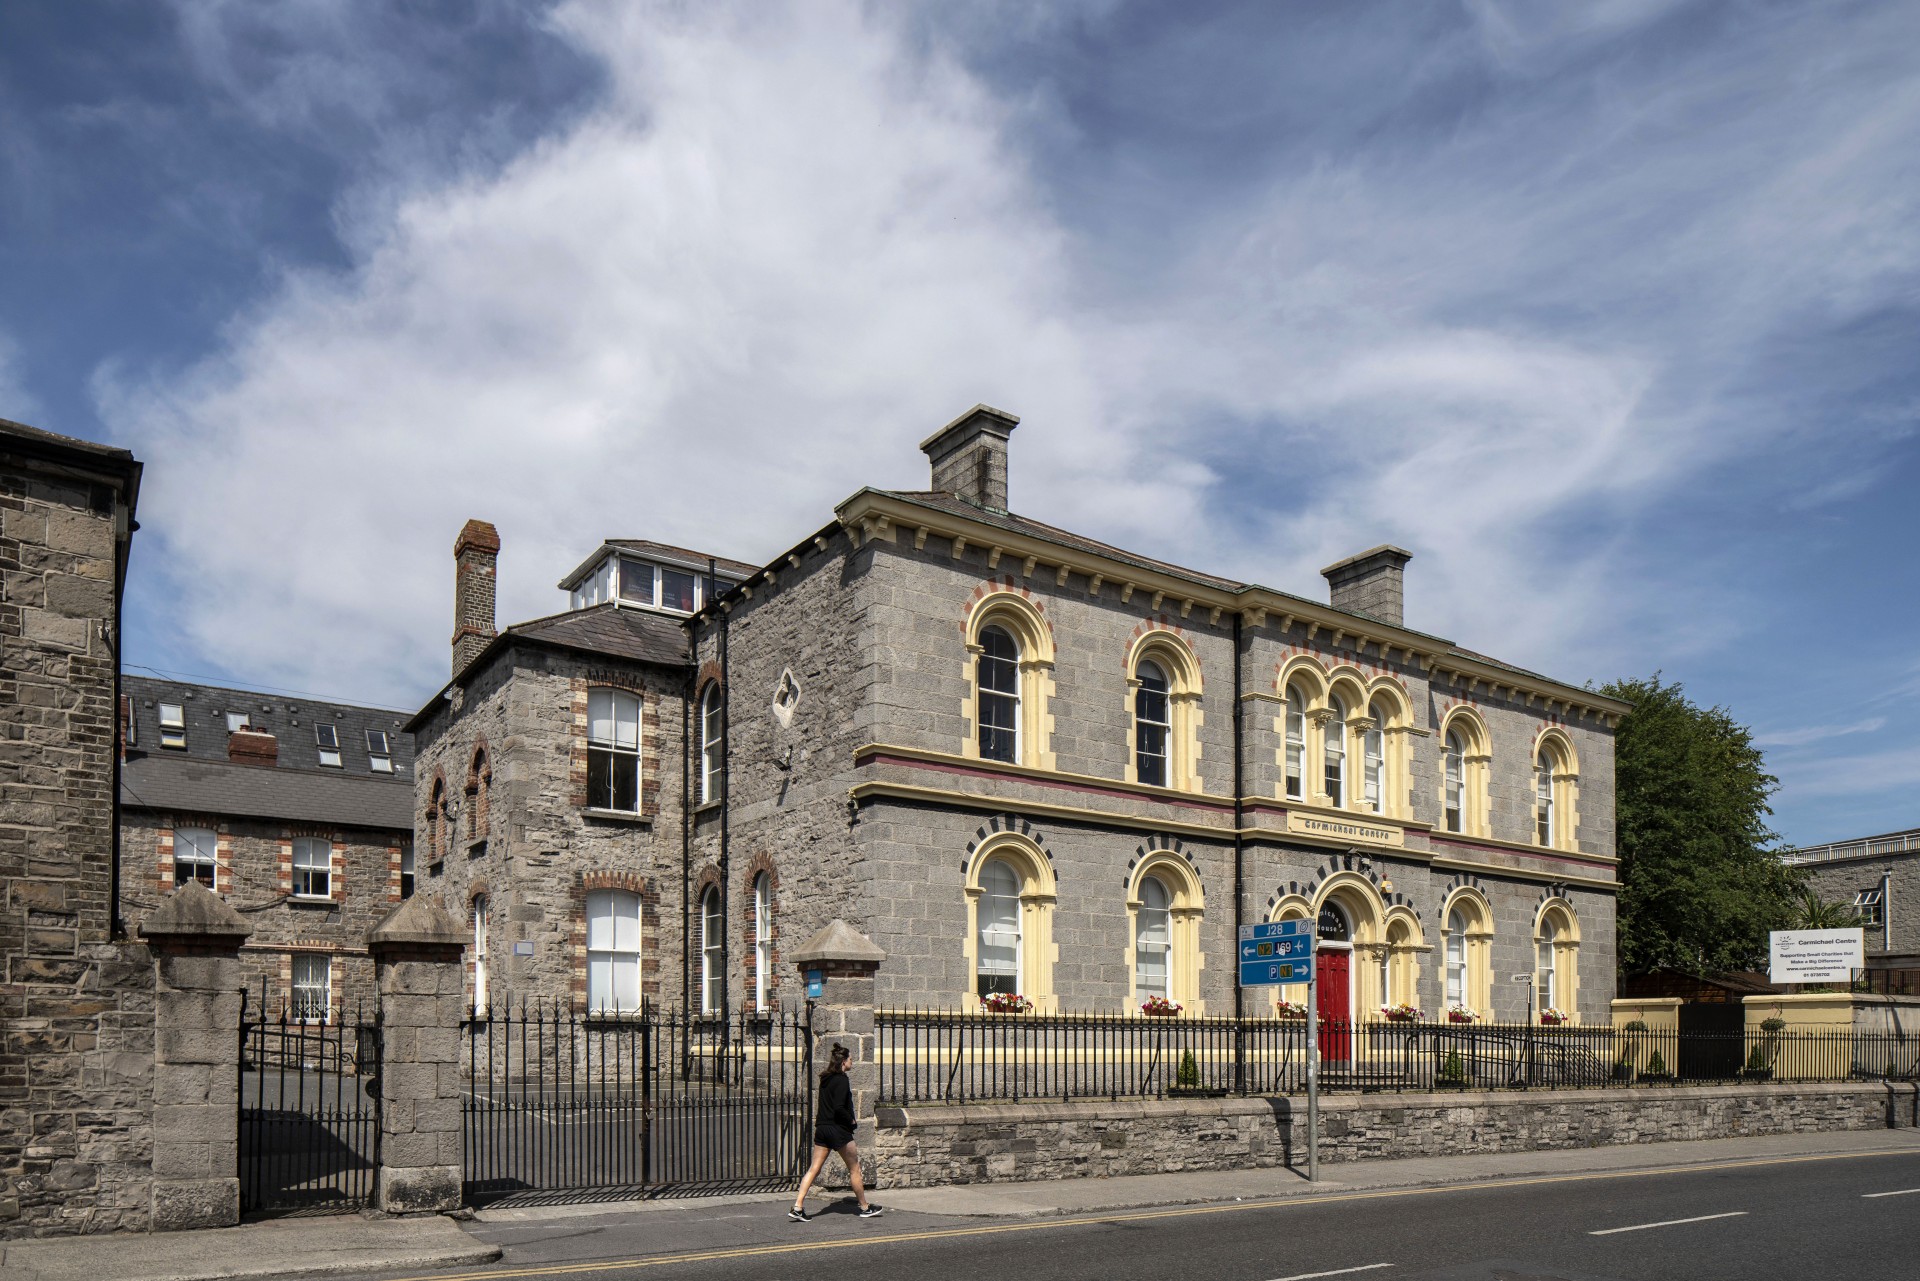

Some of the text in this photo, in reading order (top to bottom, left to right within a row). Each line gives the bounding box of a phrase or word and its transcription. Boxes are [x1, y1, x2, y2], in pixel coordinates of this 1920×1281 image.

[1304, 820, 1389, 839] Carmichael Centre
[1266, 924, 1283, 936] J28
[1798, 938, 1834, 946] Carmichael
[1258, 943, 1272, 956] N2
[1270, 966, 1292, 977] P N1
